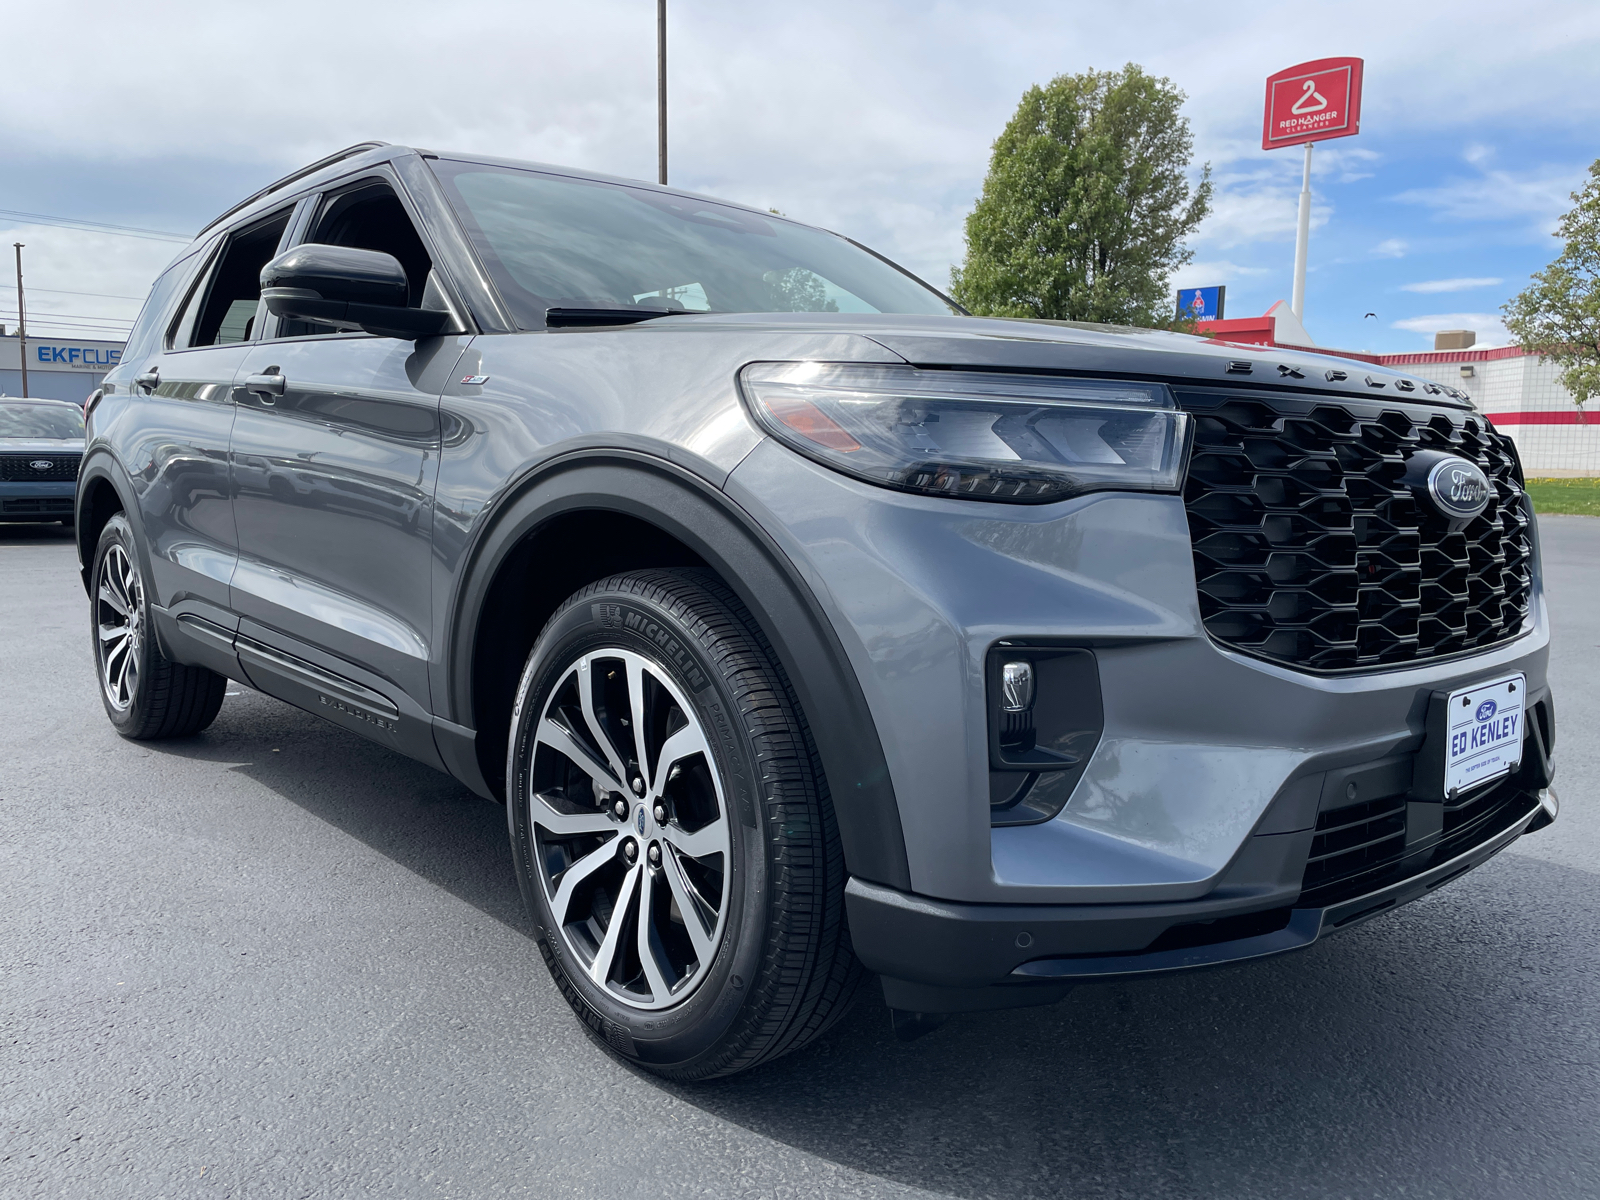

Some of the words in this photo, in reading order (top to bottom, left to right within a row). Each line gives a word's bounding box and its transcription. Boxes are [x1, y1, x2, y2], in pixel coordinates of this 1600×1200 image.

[1280, 119, 1297, 128] RED
[1298, 111, 1338, 124] HANGER
[1286, 121, 1329, 133] CLEANERS
[1451, 469, 1487, 502] Ford
[624, 611, 705, 687] MICHELIN
[1479, 703, 1494, 720] Ford
[709, 703, 745, 780] PRIMACY
[1451, 731, 1467, 757] ED
[1470, 713, 1519, 750] KENLEY
[539, 943, 601, 1032] MICHELIN
